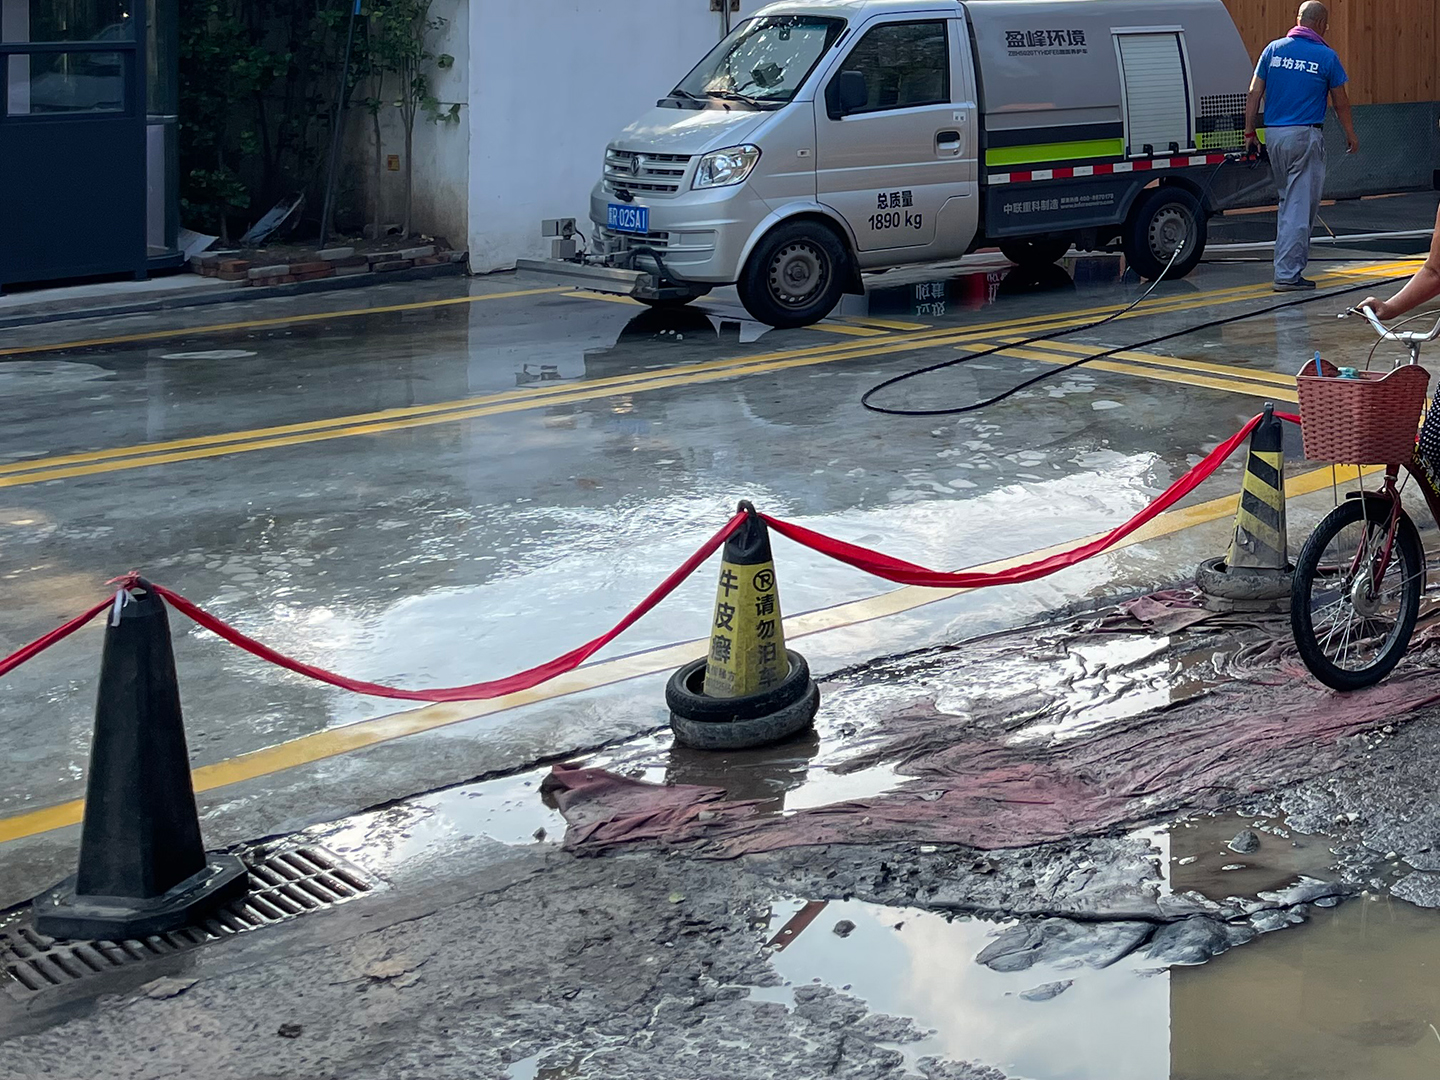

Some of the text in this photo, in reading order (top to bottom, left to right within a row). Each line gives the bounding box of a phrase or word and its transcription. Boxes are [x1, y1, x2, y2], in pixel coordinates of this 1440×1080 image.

[1005, 29, 1087, 48] 盈峰环境
[877, 190, 913, 210] 总质量
[1003, 199, 1059, 215] 中联重科制造
[868, 210, 923, 231] 1890 kg
[710, 569, 739, 664] 牛皮癣
[755, 593, 778, 688] 请勿泊车
